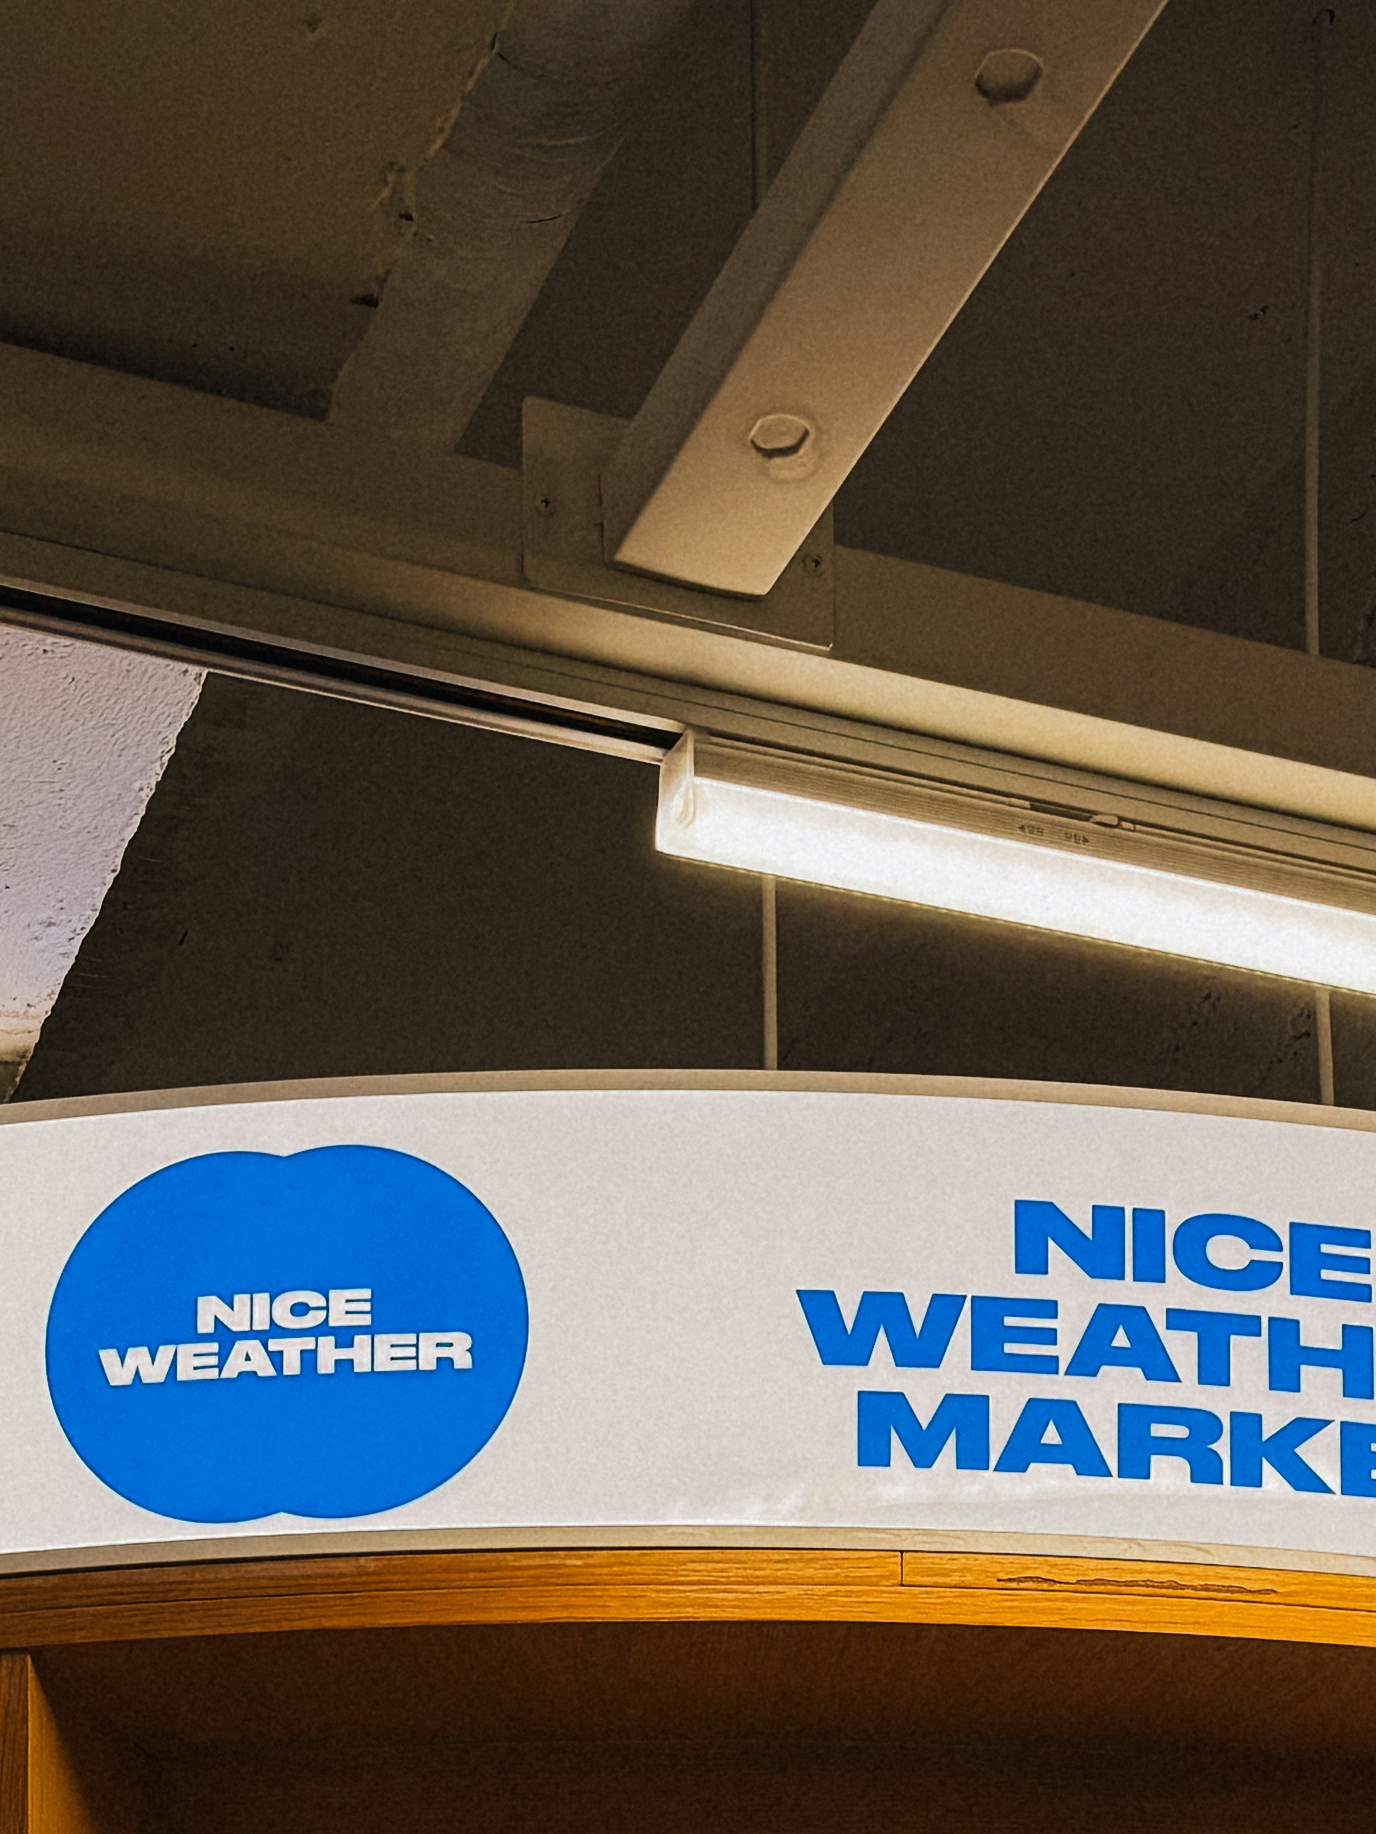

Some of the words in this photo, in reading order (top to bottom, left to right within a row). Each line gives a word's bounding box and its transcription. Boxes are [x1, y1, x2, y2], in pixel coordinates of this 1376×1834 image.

[1014, 1199, 1373, 1303] NICE
[196, 1287, 373, 1334] NICE
[98, 1331, 473, 1386] WEATHER
